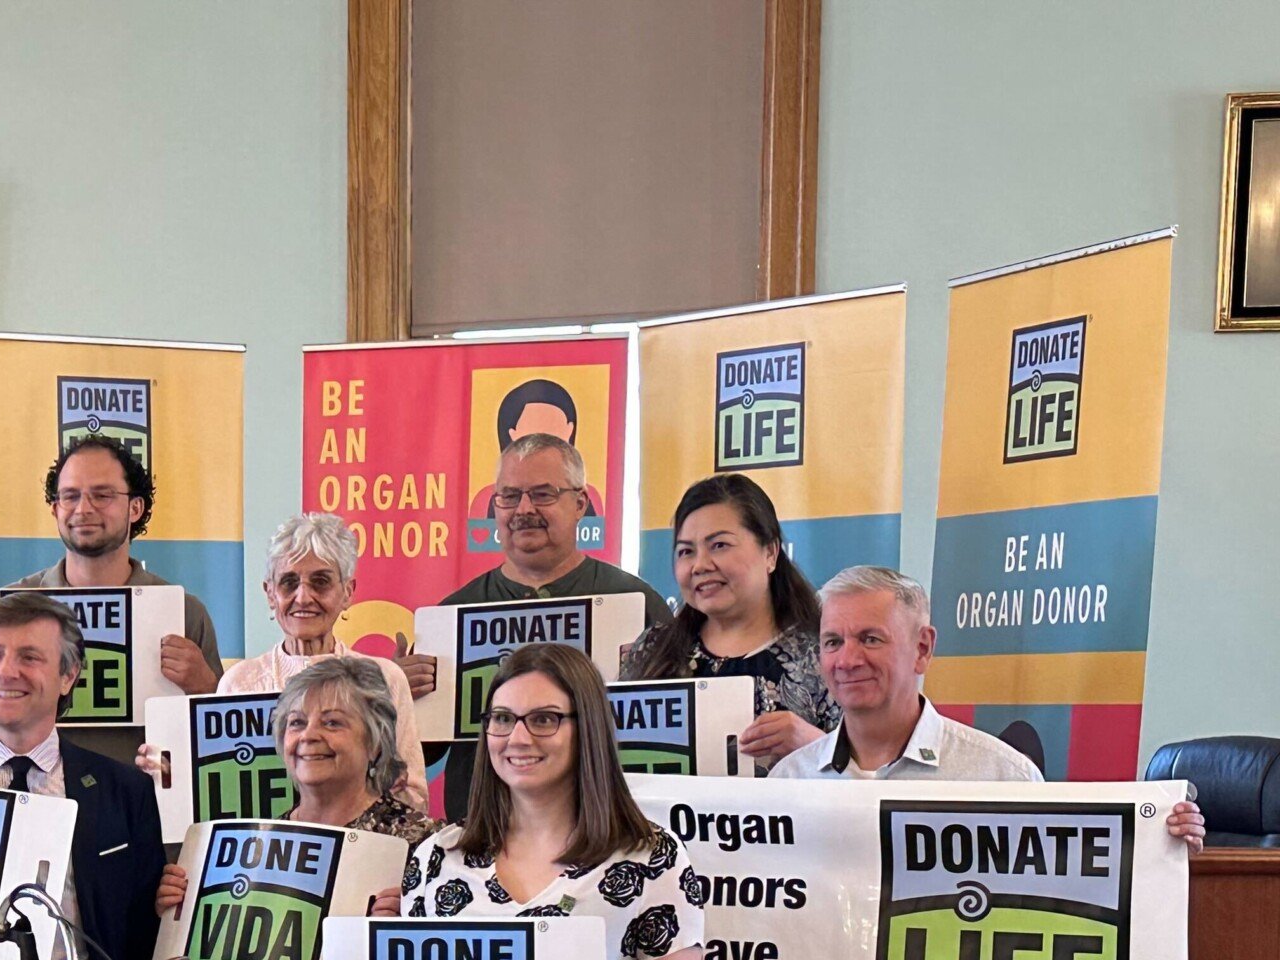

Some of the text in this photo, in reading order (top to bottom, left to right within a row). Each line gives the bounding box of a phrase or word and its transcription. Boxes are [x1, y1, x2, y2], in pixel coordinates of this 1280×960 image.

[1018, 330, 1079, 368] DONATE
[725, 355, 798, 388] DONATE
[67, 387, 143, 413] DONATE
[322, 380, 365, 416] BE
[724, 408, 796, 459] LIFE
[1013, 390, 1075, 449] LIFE
[320, 427, 366, 464] AN
[320, 473, 446, 512] ORGAN
[348, 521, 449, 558] ONOR
[1005, 532, 1064, 573] BE AN
[956, 584, 1108, 629] ORGAN DONOR
[470, 613, 580, 647] DONATE
[610, 698, 682, 730] NATE
[669, 803, 794, 852] Organ
[215, 836, 322, 875] DONE
[904, 824, 1111, 878] DONATE
[700, 874, 807, 909] nors
